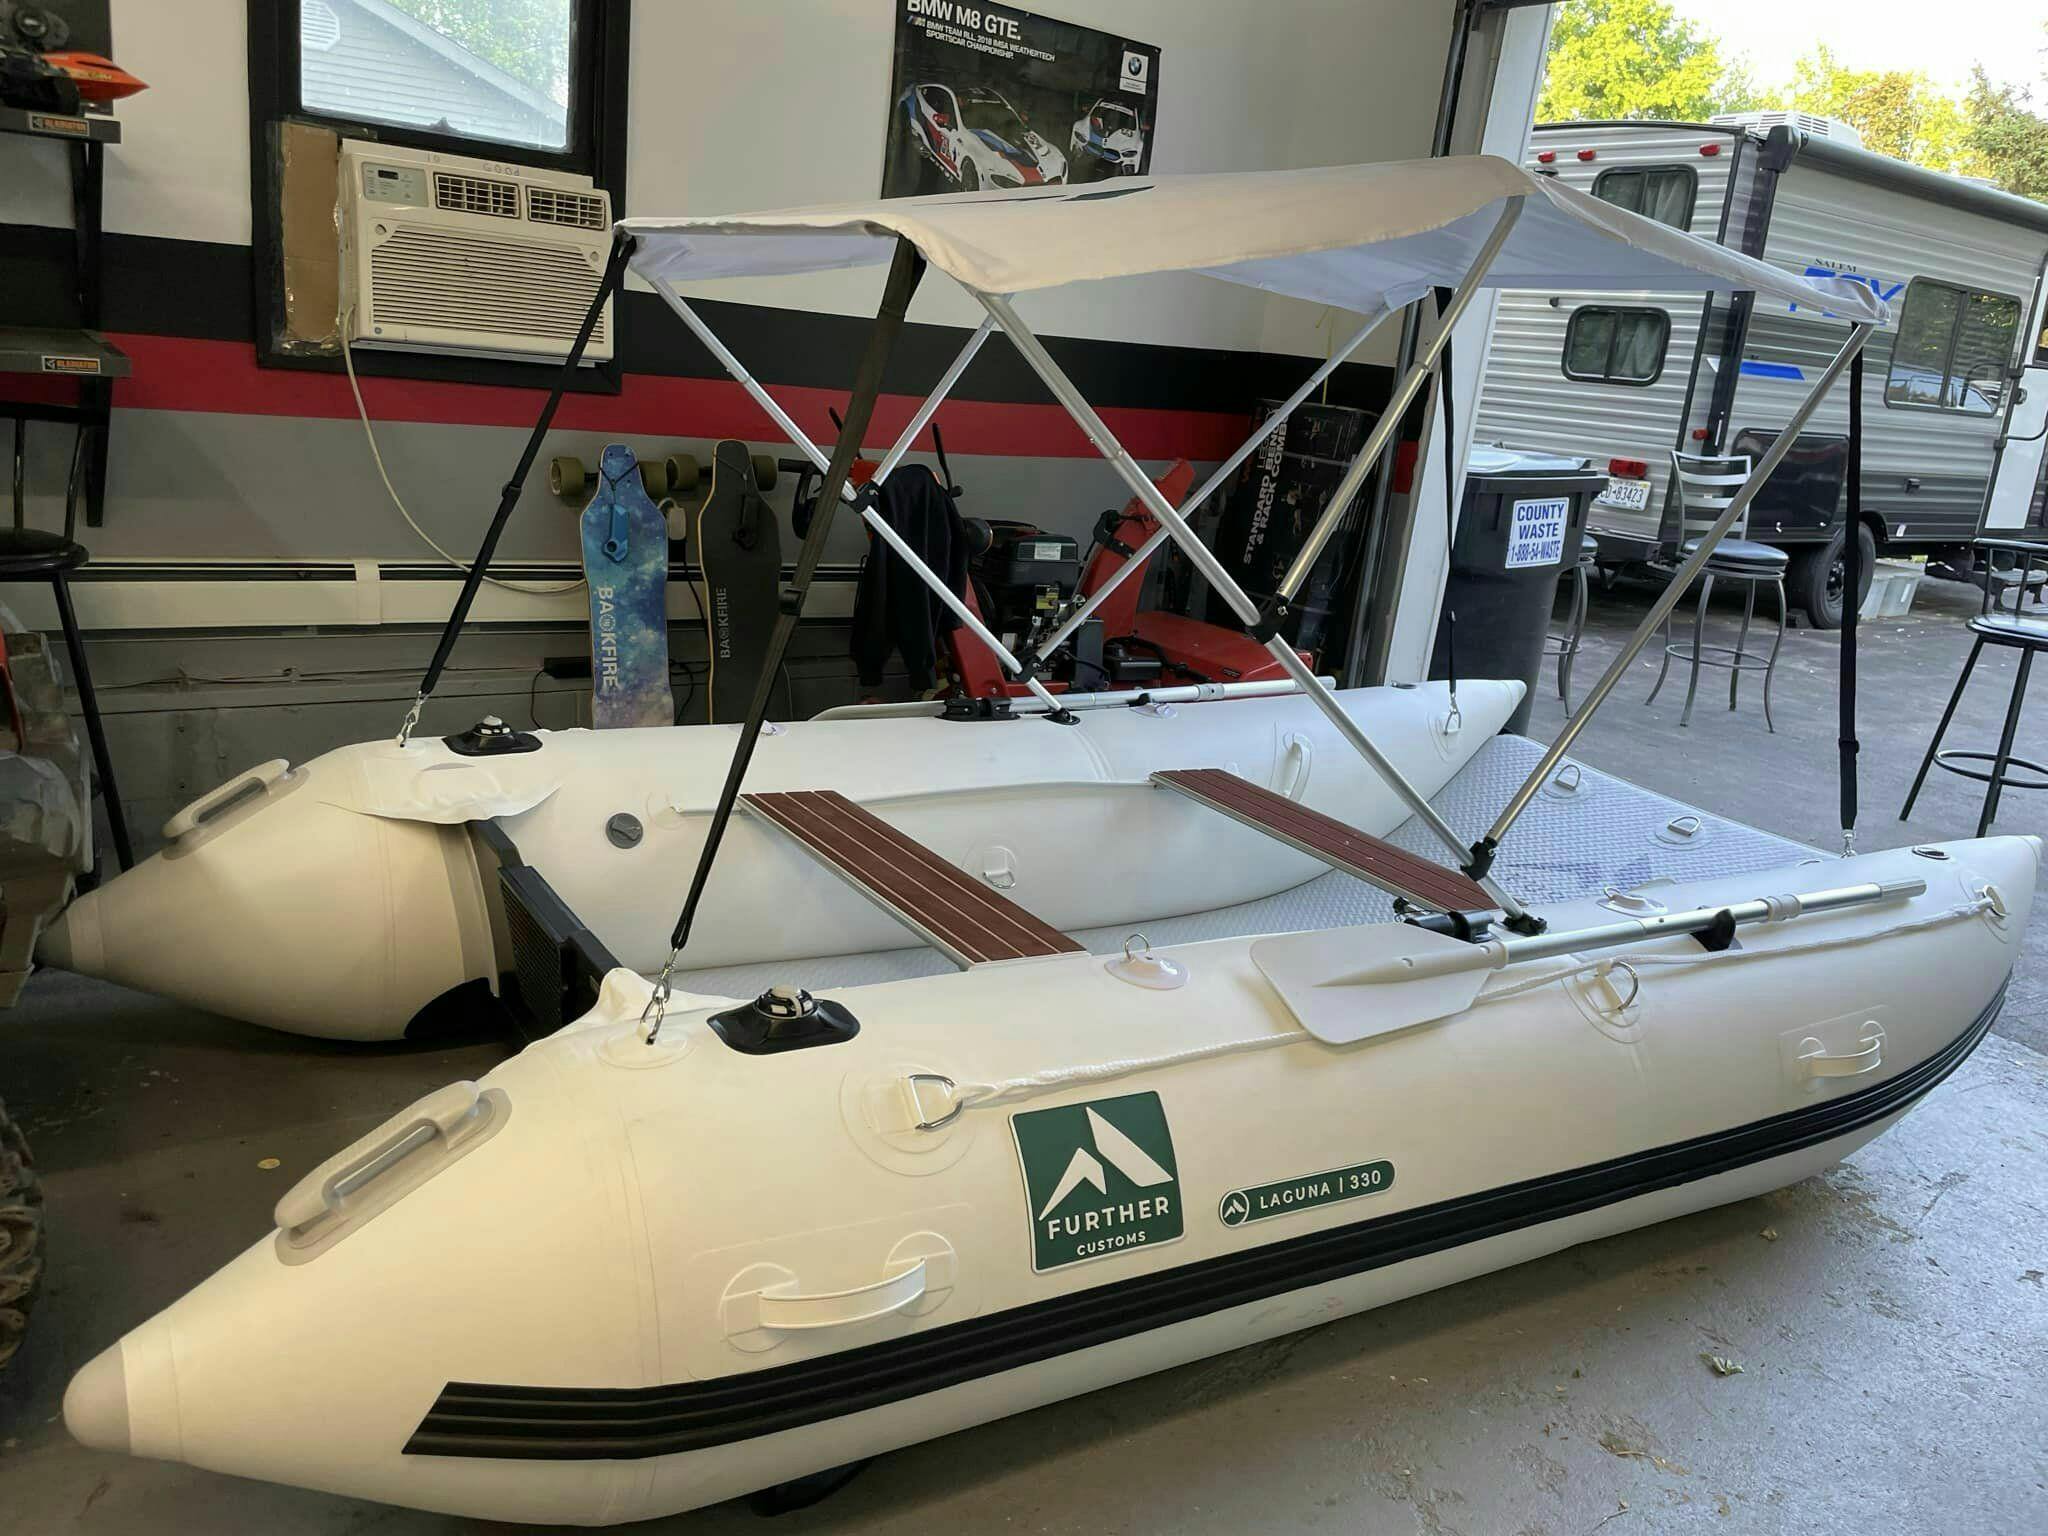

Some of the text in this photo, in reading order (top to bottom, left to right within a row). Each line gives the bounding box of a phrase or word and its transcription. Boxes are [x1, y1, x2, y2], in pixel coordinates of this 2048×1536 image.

[907, 0, 1021, 40] BMW M8 GTE.
[926, 30, 966, 47] SPORTSCAR
[926, 20, 944, 32] BMW
[945, 23, 963, 36] TEAM
[1009, 43, 1056, 61] WEATHERTECH
[1815, 258, 1857, 272] SALEM
[1243, 475, 1270, 564] STANDARD
[1260, 482, 1276, 529] RACK
[1517, 504, 1565, 522] COUNTY
[1519, 522, 1559, 540] WASTE
[1260, 1182, 1331, 1209] LAGUNA
[1350, 1170, 1382, 1190] 330
[1048, 1197, 1170, 1240] FURTHER
[1076, 1231, 1147, 1257] CUSTOMS
